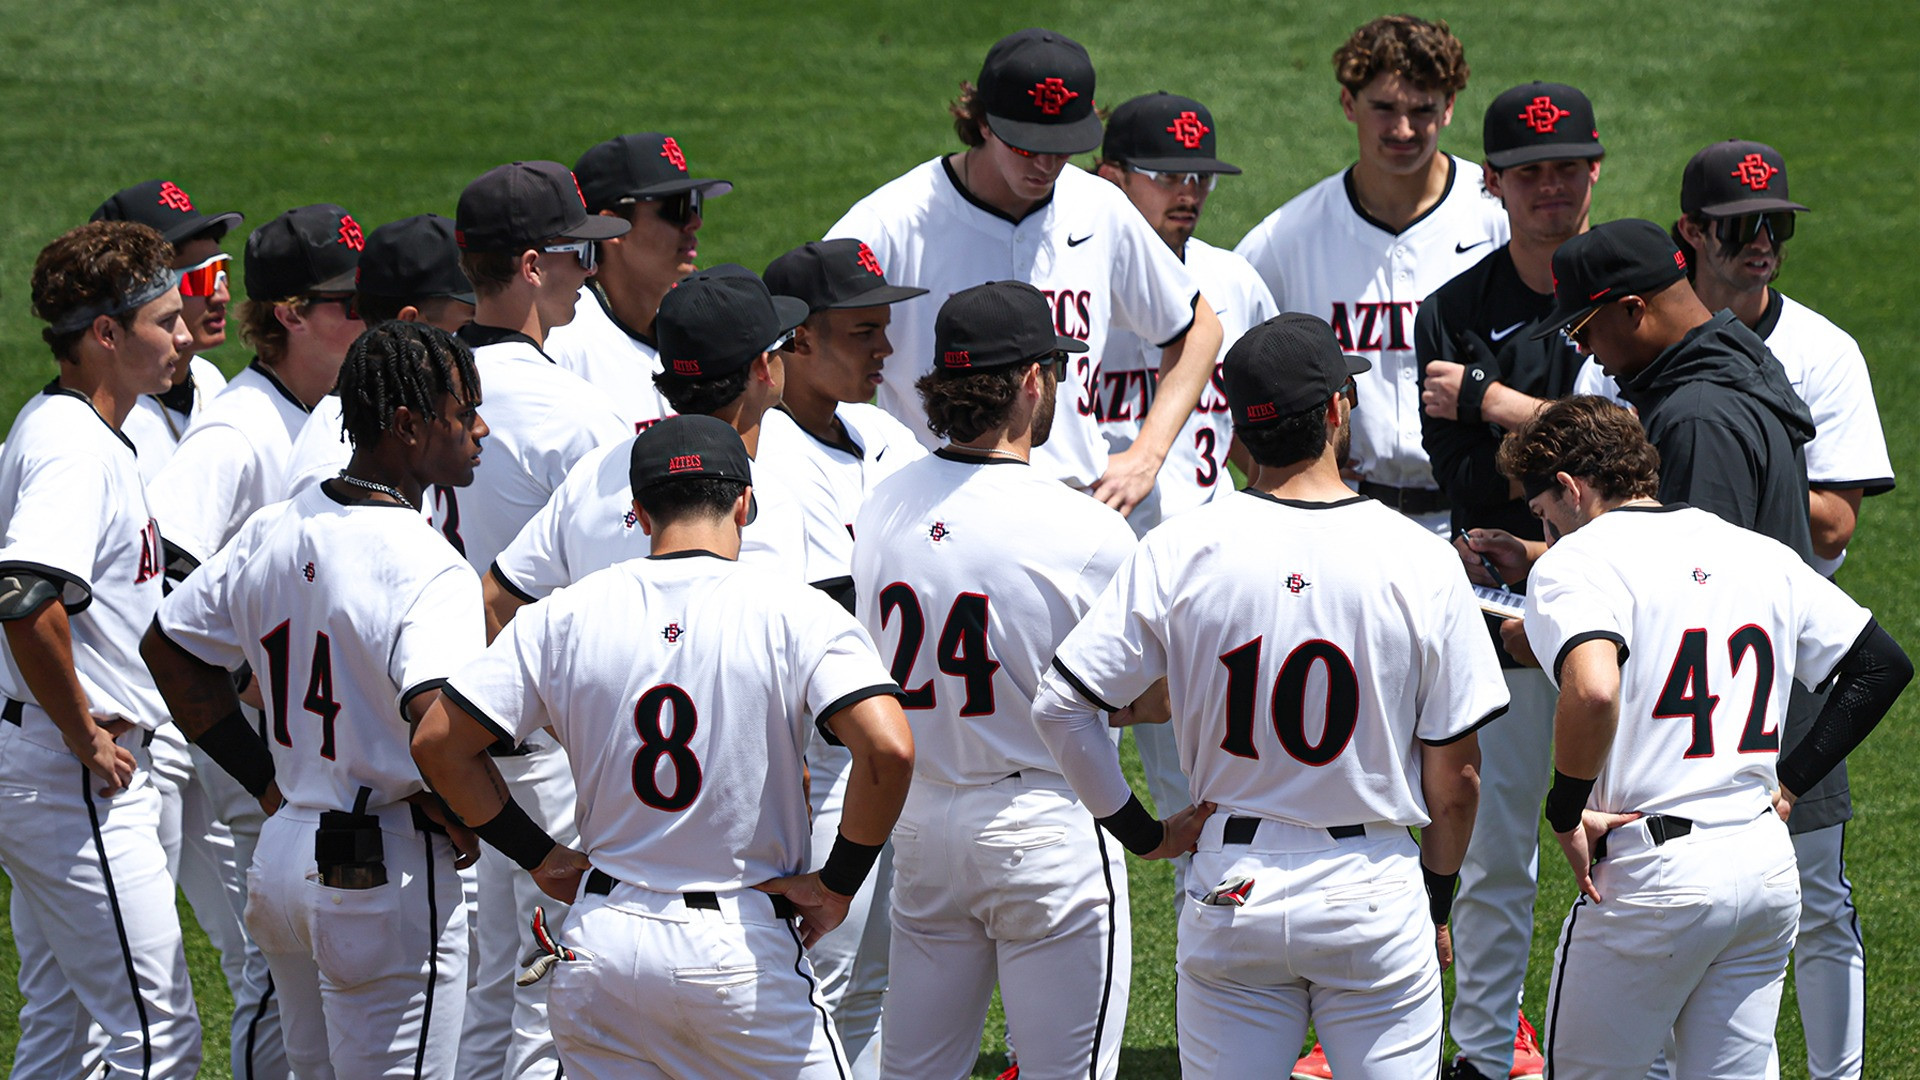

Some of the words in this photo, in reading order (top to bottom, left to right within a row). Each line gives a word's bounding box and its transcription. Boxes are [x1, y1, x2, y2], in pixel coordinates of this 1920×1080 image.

[673, 360, 699, 371] AZTECS
[1331, 301, 1424, 351] AZT
[669, 454, 701, 470] AZTECS
[1247, 402, 1276, 417] AZTECS
[259, 618, 342, 761] 14
[879, 581, 1001, 717] 24
[1218, 634, 1360, 767] 10
[1652, 623, 1780, 759] 42
[631, 683, 702, 812] 8
